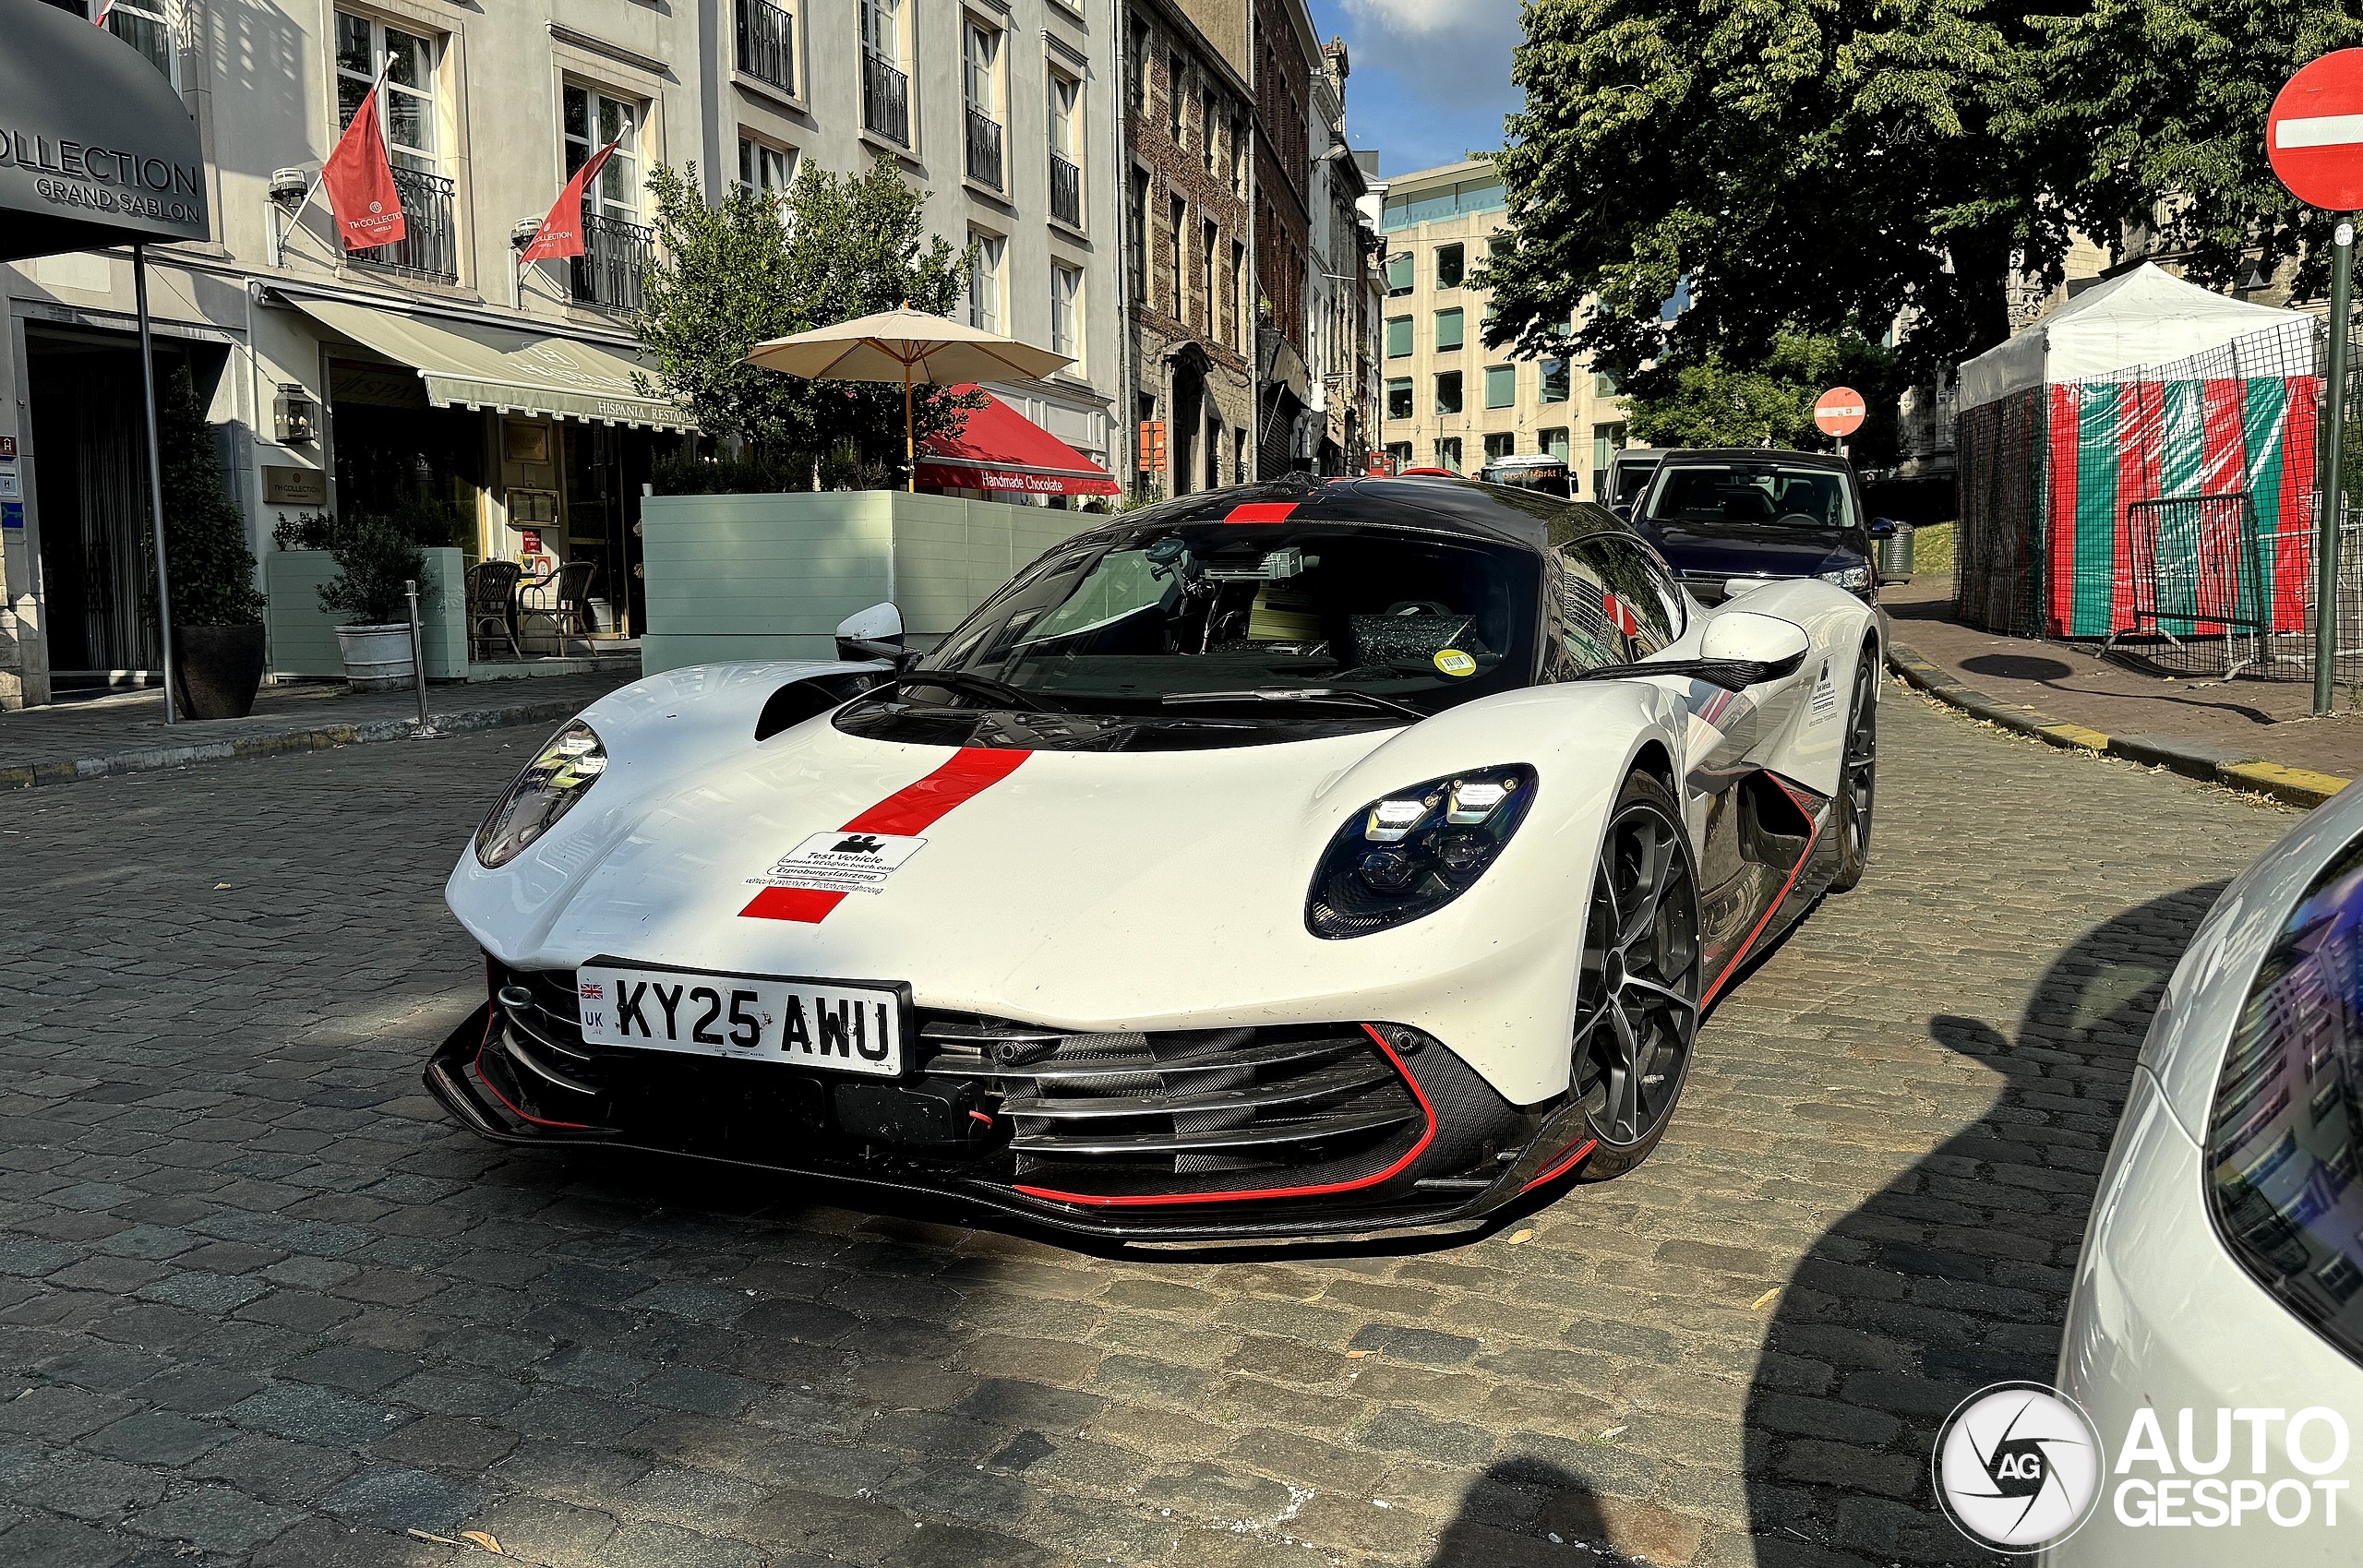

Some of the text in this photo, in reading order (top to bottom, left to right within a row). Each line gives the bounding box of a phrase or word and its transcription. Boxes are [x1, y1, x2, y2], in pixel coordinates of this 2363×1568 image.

[35, 178, 200, 223] GRAND SABLON
[597, 401, 646, 418] HISPANIA
[981, 471, 1063, 492] Handmade Chocolate
[808, 852, 883, 864] Test Vehicle
[776, 867, 878, 881] Erprobungsfahrzeug
[584, 1011, 604, 1027] UK
[615, 979, 889, 1062] KY25 AWU
